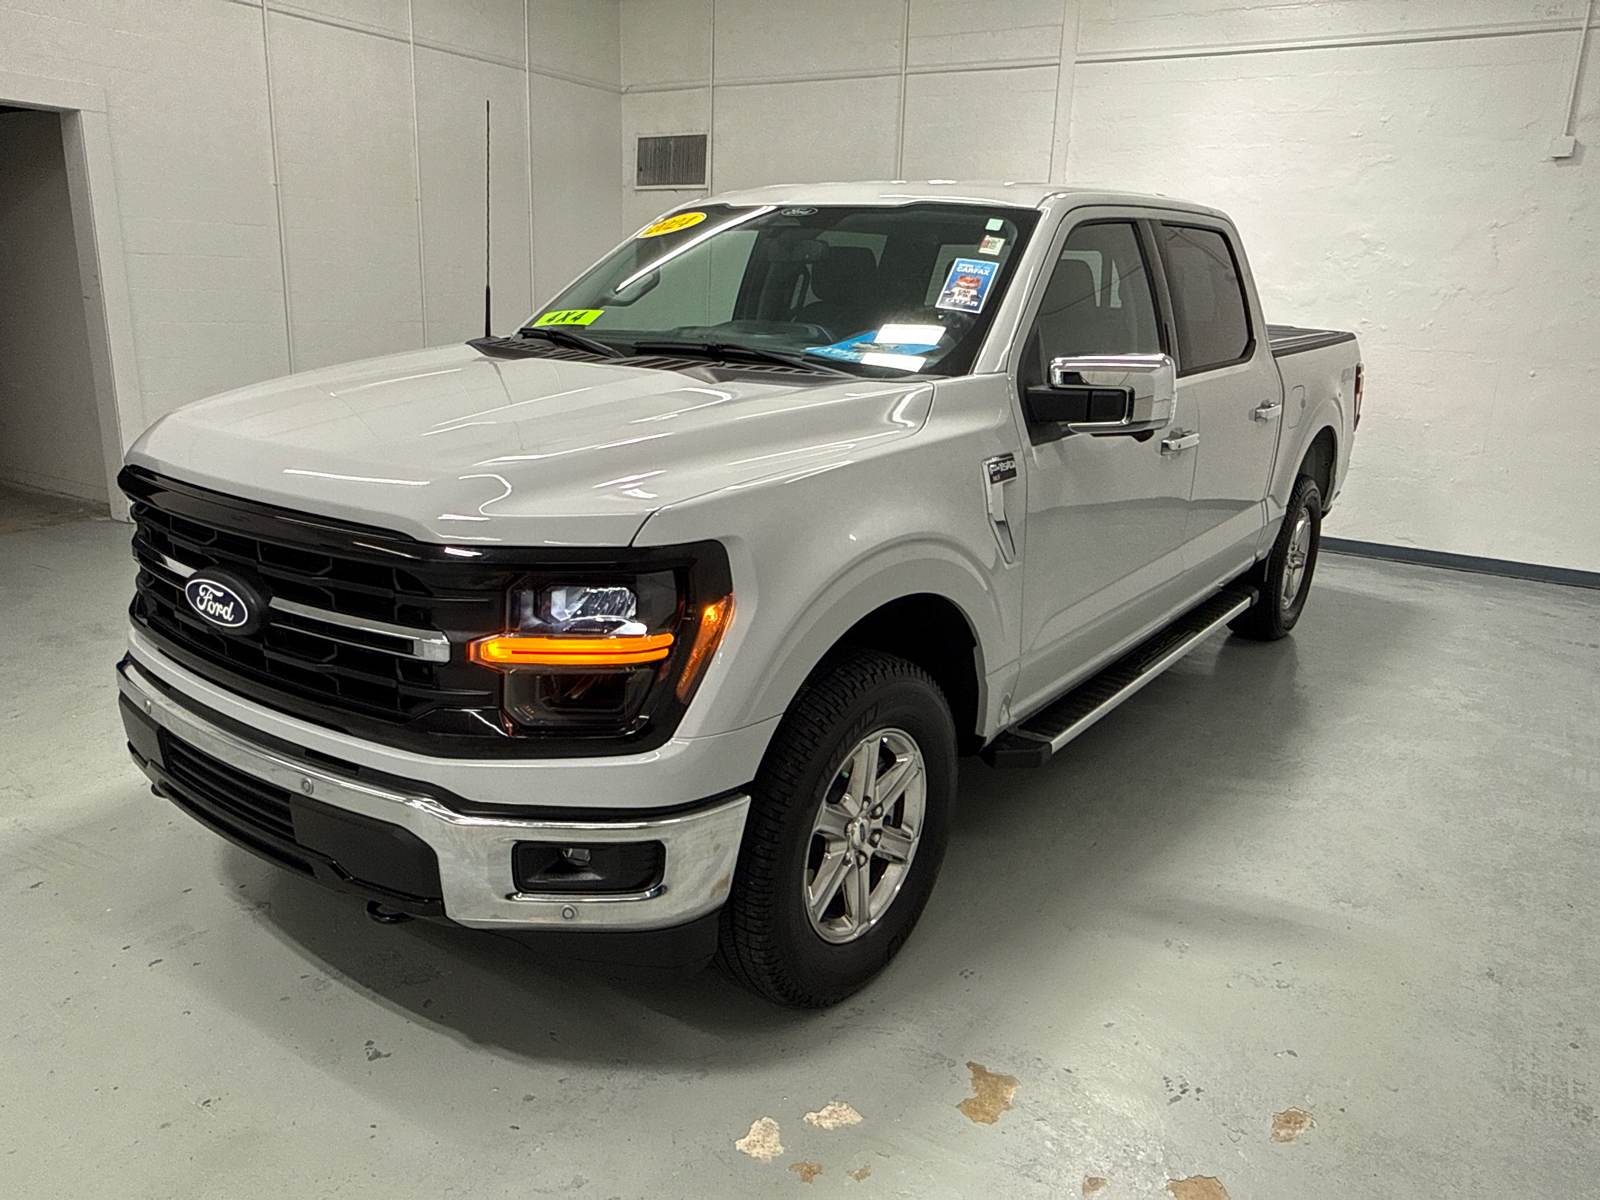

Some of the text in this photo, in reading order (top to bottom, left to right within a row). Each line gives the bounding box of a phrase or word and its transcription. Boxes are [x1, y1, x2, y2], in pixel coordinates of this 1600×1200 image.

[643, 215, 699, 235] 2024
[956, 266, 990, 276] CARFAX
[545, 311, 589, 323] 4X4
[989, 460, 1016, 475] F-150
[196, 584, 234, 621] Ford
